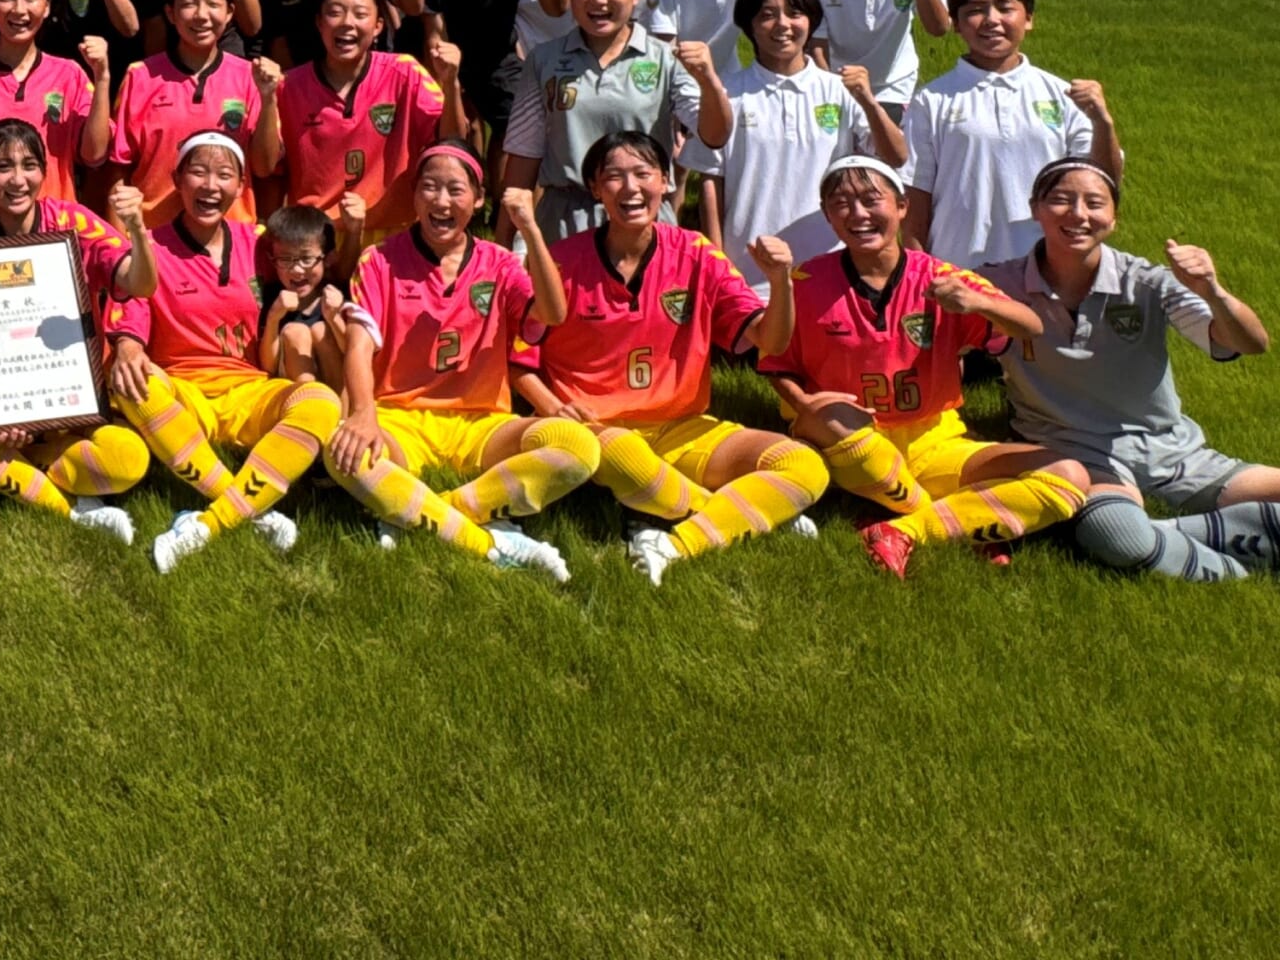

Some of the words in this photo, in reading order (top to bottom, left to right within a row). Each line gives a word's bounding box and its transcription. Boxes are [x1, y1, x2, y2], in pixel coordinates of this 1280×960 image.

[545, 74, 578, 113] 16
[344, 149, 366, 190] 9
[435, 331, 461, 374] 2
[627, 346, 652, 390] 6
[860, 369, 922, 412] 26
